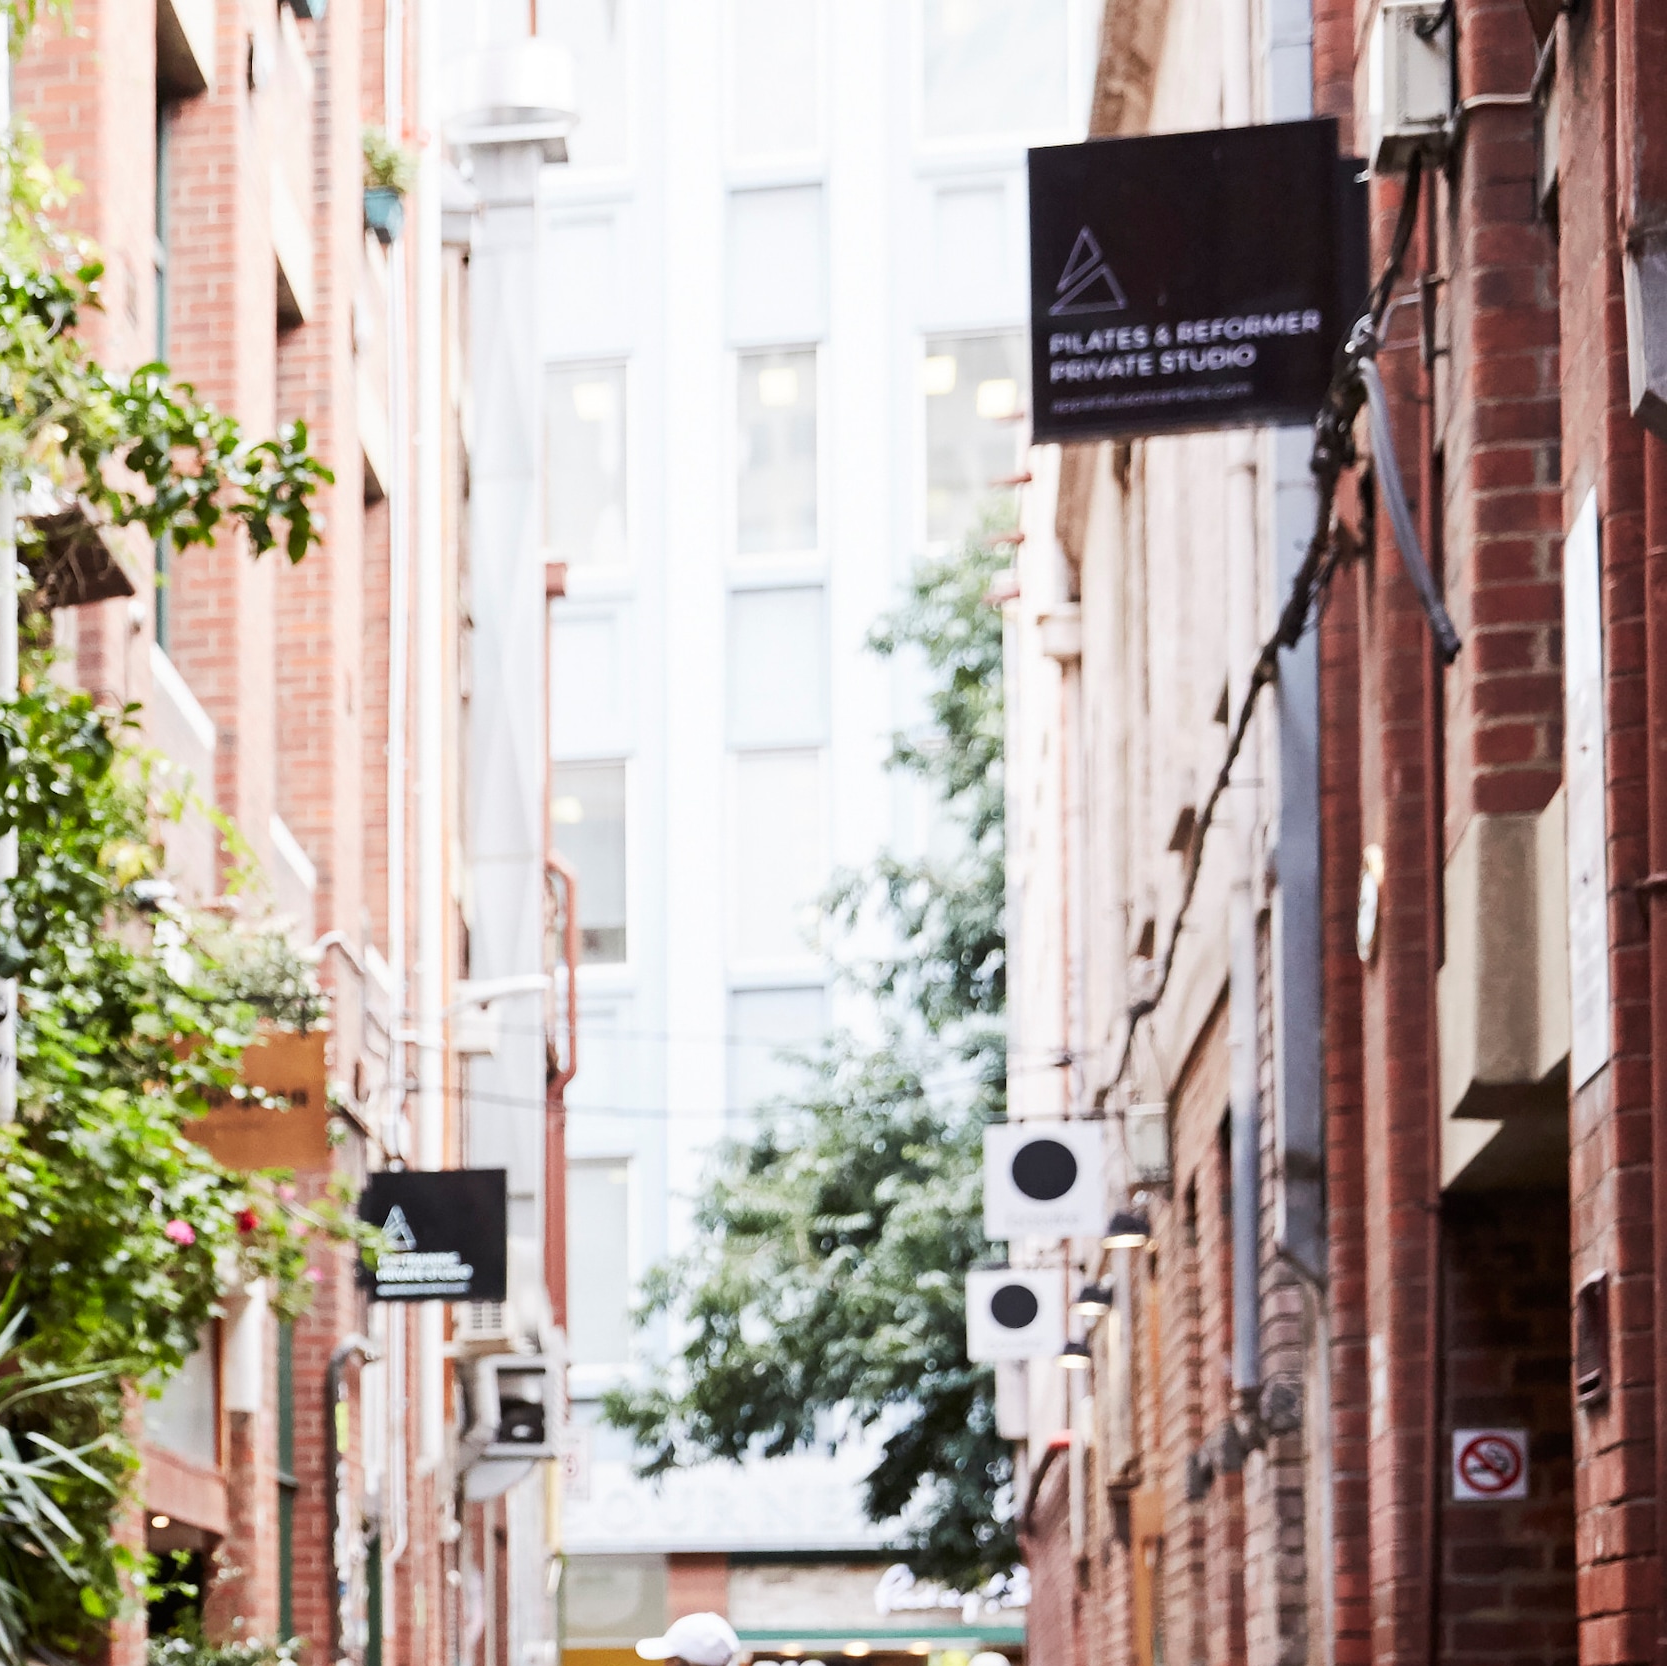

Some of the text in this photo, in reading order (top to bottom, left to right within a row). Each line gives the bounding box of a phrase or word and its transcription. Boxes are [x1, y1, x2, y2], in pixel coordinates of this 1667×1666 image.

[1049, 308, 1322, 356] PILATES & REFORMER
[1050, 343, 1258, 384] PRIVATE STUDIO
